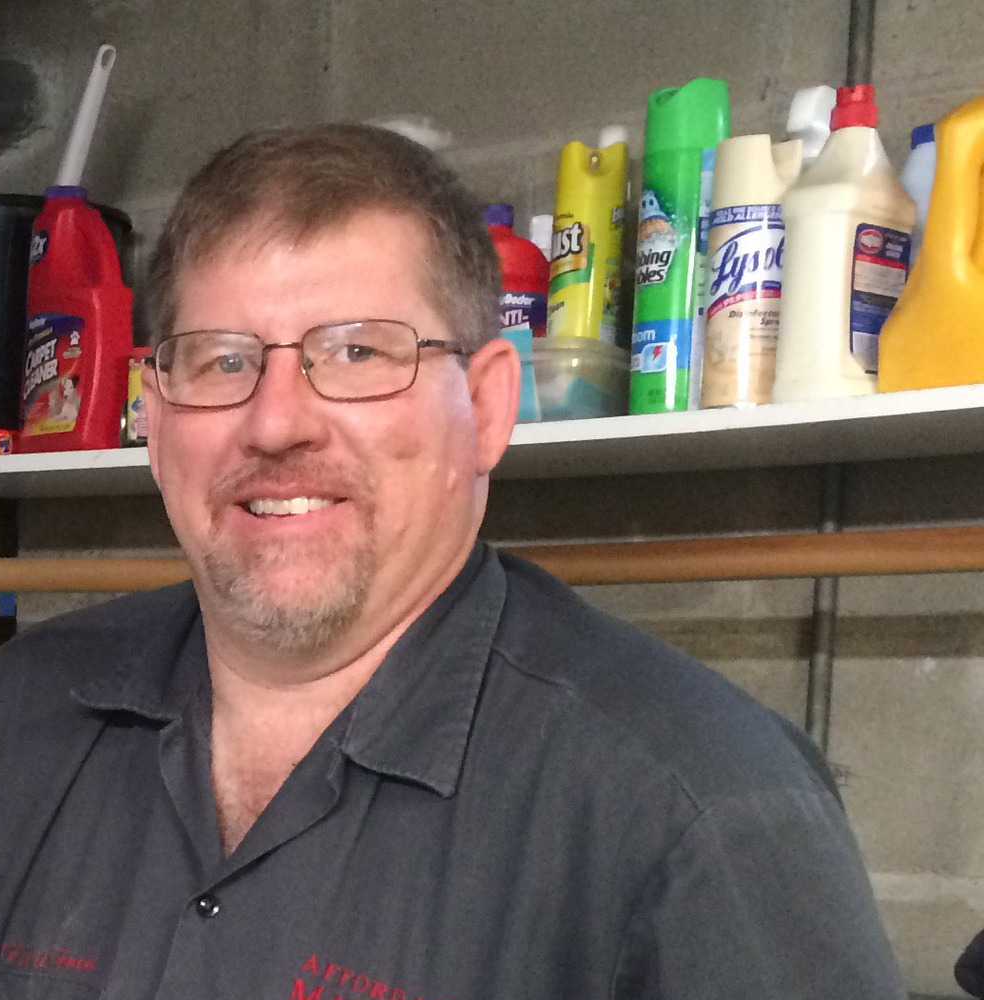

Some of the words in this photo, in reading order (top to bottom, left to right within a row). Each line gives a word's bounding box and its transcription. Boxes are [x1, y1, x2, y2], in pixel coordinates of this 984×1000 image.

[551, 222, 581, 259] ust
[636, 248, 671, 267] bing
[710, 236, 785, 296] Lysol
[636, 268, 665, 285] bles
[500, 309, 529, 326] NTI-
[632, 329, 656, 343] oom
